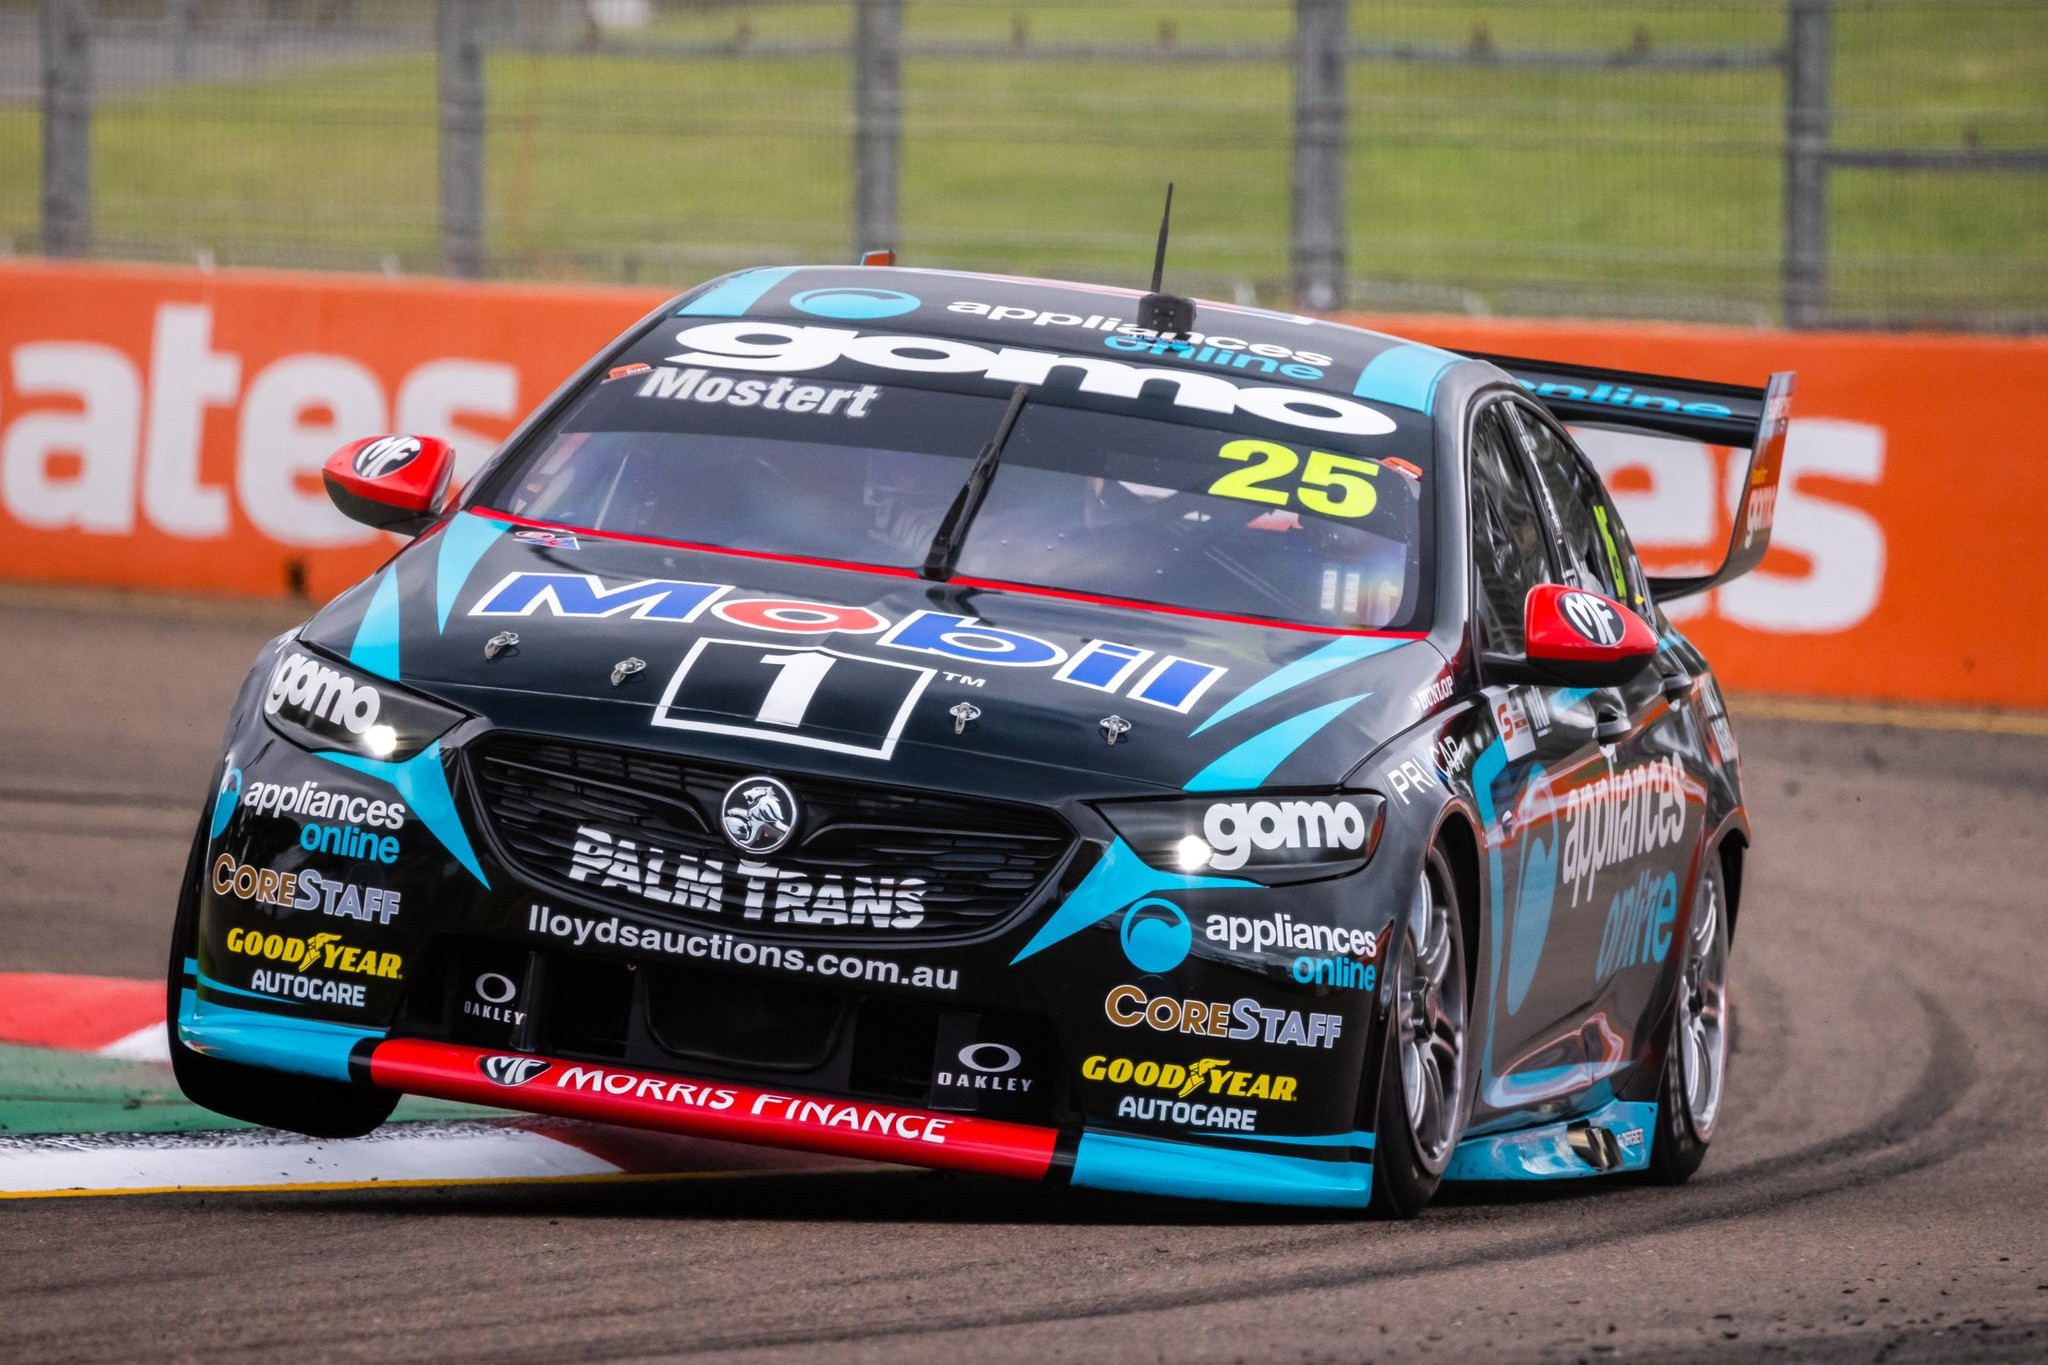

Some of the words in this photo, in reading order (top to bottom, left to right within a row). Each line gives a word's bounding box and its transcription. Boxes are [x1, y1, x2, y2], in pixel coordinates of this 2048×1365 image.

[947, 300, 1334, 367] appliances
[1104, 335, 1324, 380] online
[637, 366, 880, 421] Mostert
[665, 321, 1397, 435] gomo
[1207, 438, 1379, 518] 25
[467, 571, 1229, 713] Mobil
[265, 653, 380, 733] gomo
[754, 652, 838, 729] 1
[244, 781, 405, 830] appliances
[1204, 801, 1364, 870] gomo
[1563, 752, 1686, 908] appliances
[301, 822, 399, 863] online
[569, 825, 726, 913] PALM
[733, 858, 927, 929] TRANS
[528, 906, 959, 990] lloydsauctions.com.au
[1206, 913, 1377, 958] appliances
[1596, 868, 1677, 984] online
[251, 968, 366, 1007] AUTOCARE
[1292, 956, 1376, 991] online
[464, 1001, 526, 1025] OAKLEY
[556, 1066, 734, 1110] MORRIS
[751, 1092, 953, 1143] FINANCE
[938, 1072, 1033, 1092] OAKLEY
[1118, 1096, 1257, 1131] AUTOCARE
